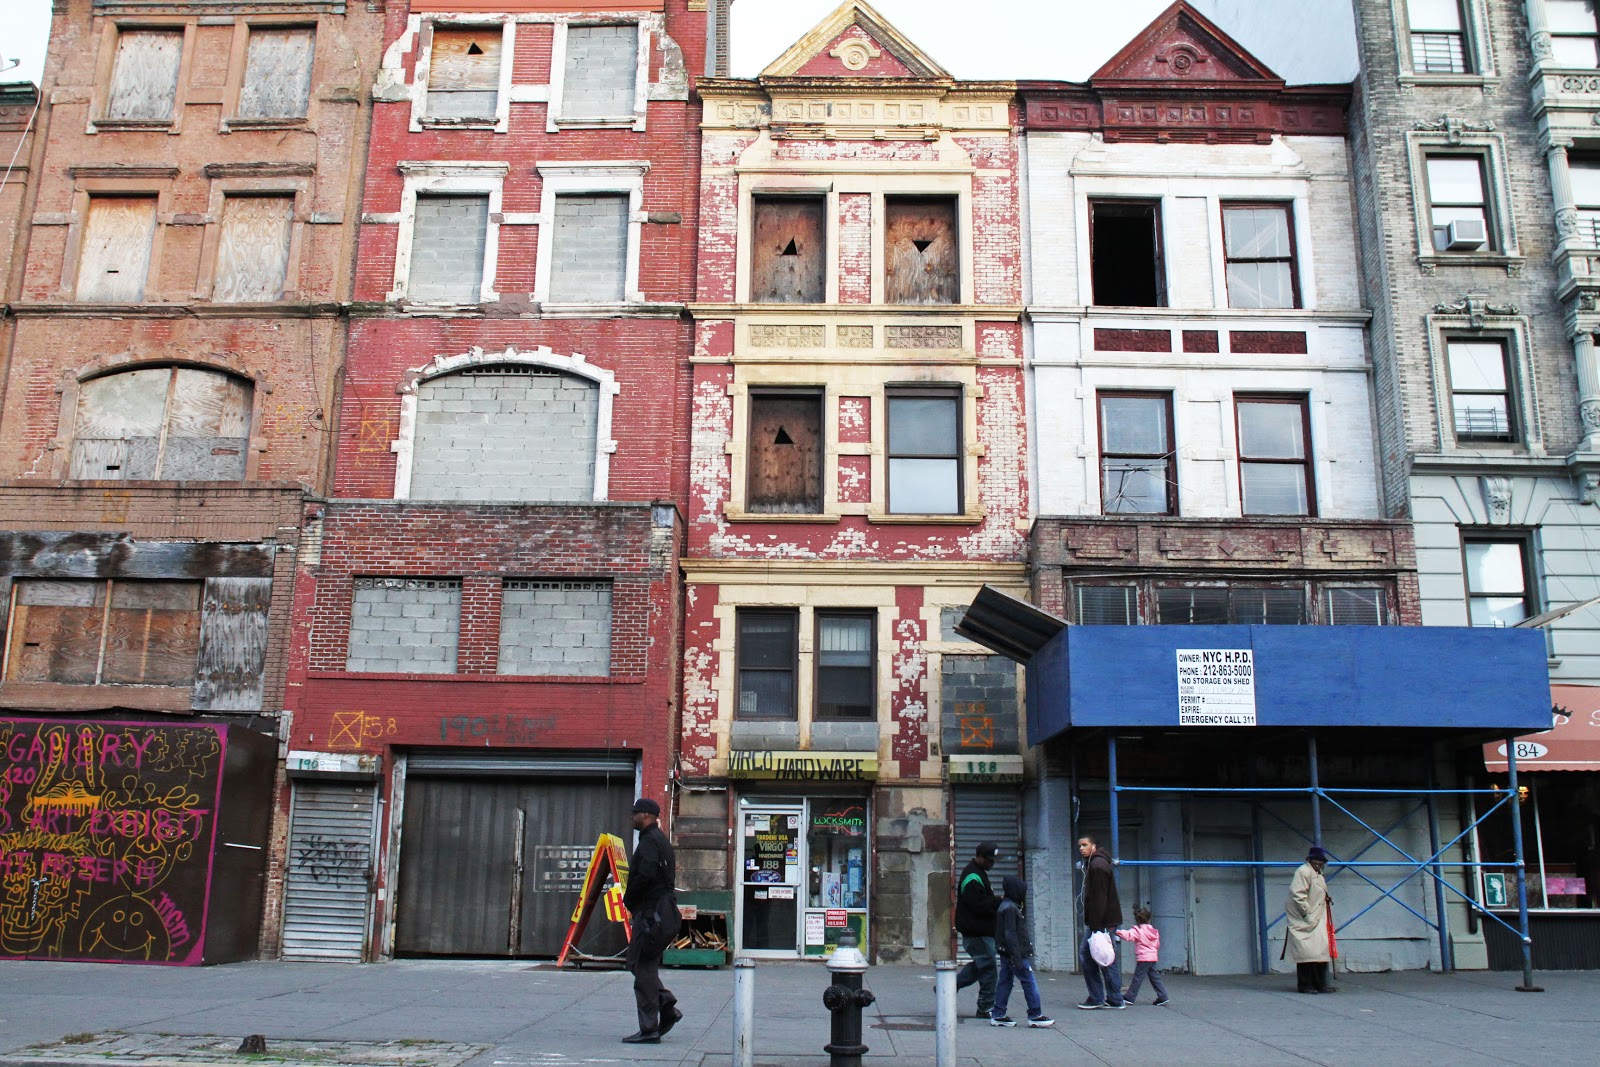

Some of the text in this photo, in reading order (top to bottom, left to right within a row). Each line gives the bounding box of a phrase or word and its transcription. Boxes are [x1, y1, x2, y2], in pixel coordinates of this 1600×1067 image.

[1179, 651, 1251, 663] OWNER: NYC H.P.D.
[1203, 664, 1252, 677] 212-863-5000
[1192, 677, 1221, 685] STORAGE
[1180, 696, 1200, 704] PERMIT
[1181, 705, 1202, 714] EXPIRE:
[1181, 715, 1255, 724] EMERGENCY CALL 311
[441, 716, 488, 741] 190
[1515, 743, 1539, 758] 84
[299, 758, 319, 770] 190
[759, 842, 784, 852] VIRGO
[557, 860, 591, 869] STO
[762, 860, 780, 870] 188
